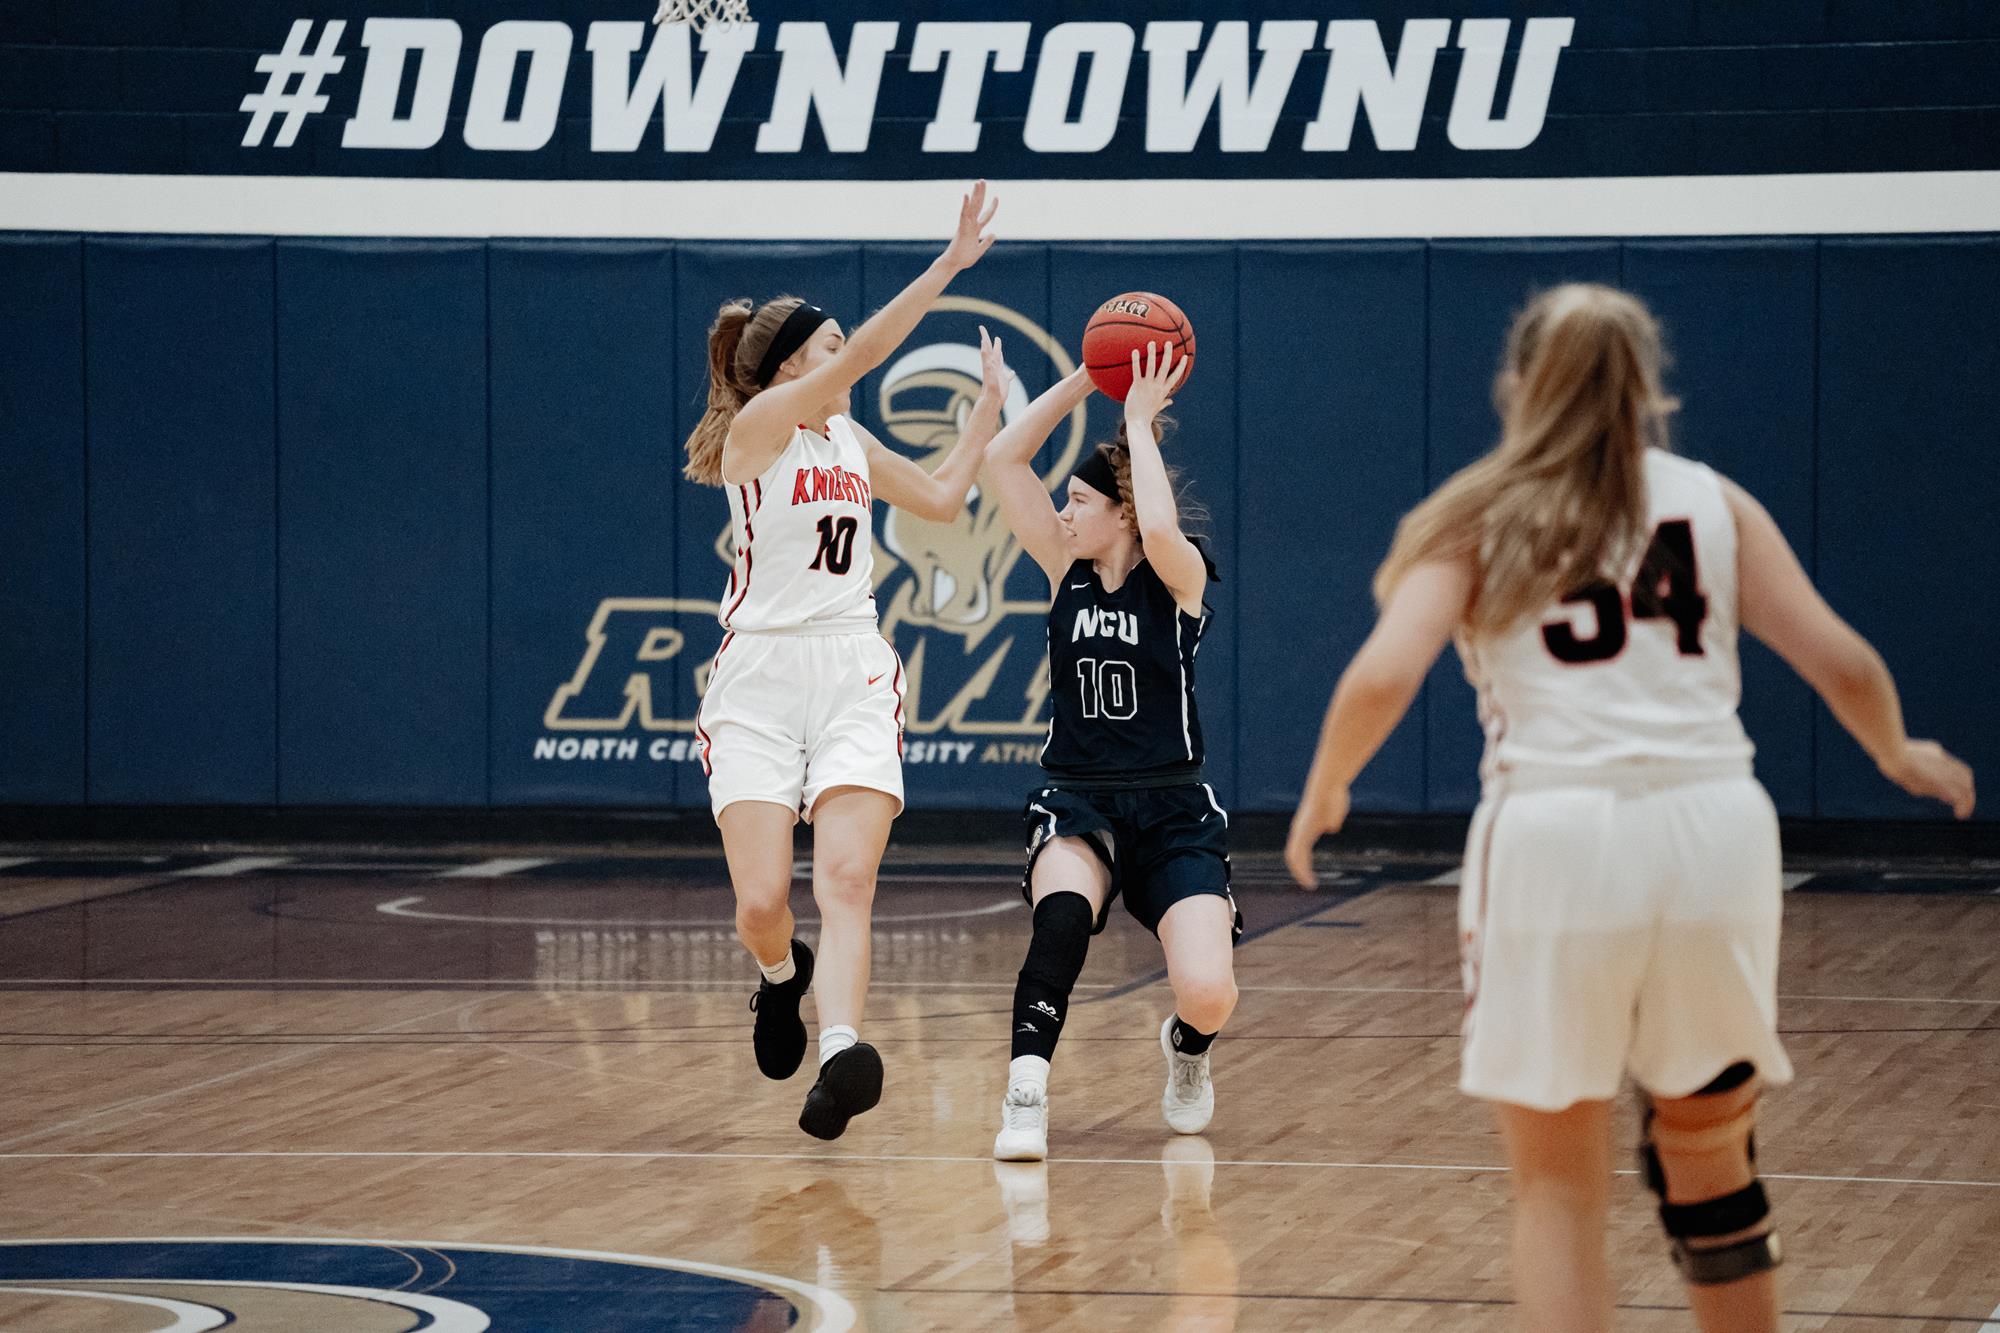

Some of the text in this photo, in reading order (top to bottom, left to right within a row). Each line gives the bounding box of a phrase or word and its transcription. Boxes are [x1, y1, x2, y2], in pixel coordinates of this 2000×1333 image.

[239, 17, 1576, 153] #DOWNTOWNU
[808, 514, 858, 576] 10
[1072, 605, 1139, 646] NCU
[1076, 657, 1138, 720] 10
[533, 737, 640, 761] NORTH
